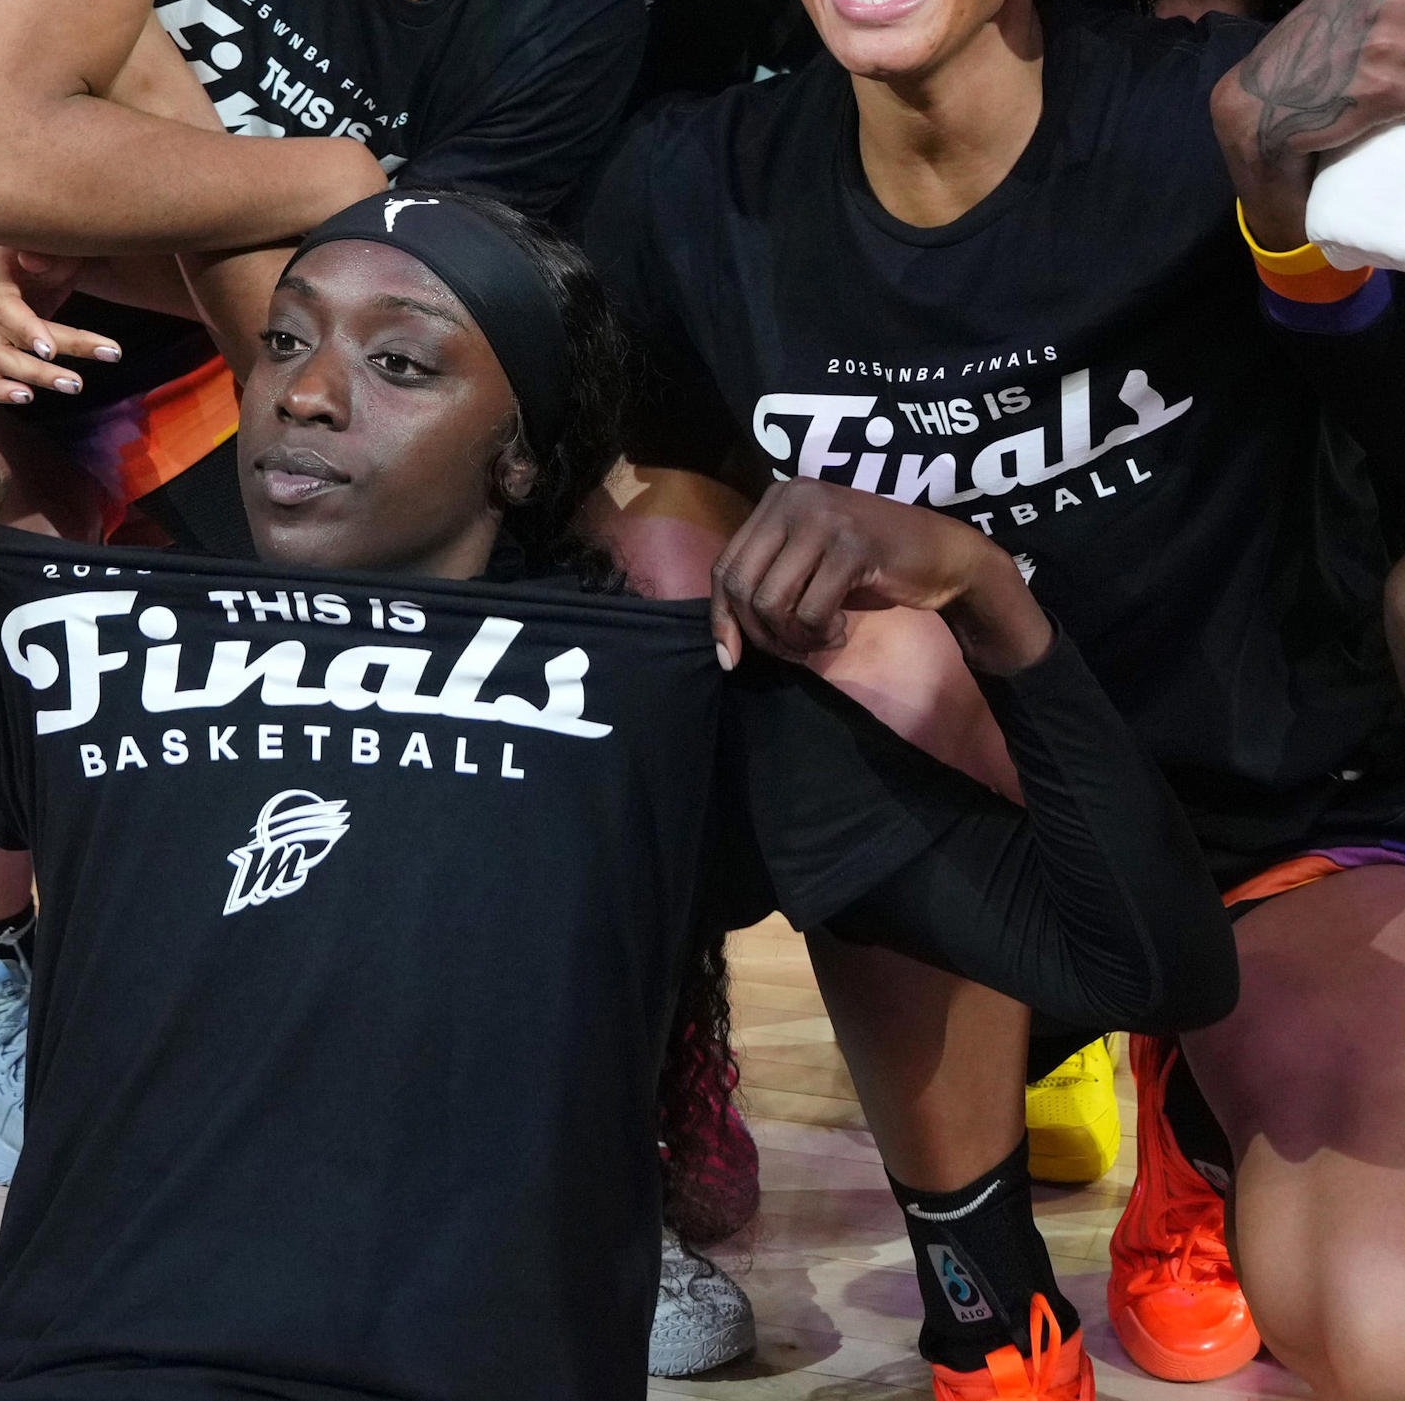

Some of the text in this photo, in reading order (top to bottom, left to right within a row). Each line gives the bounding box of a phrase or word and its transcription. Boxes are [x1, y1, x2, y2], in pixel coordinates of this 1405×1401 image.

[272, 18, 332, 74] WNBA
[258, 57, 335, 130] THIS
[962, 345, 1058, 377] FINALS
[752, 368, 1194, 508] Finals
[897, 385, 1032, 436] THIS IS
[971, 457, 1152, 537] TBALL
[208, 589, 427, 634] THIS IS
[0, 589, 614, 739] Finals
[79, 724, 526, 780] BASKETBALL
